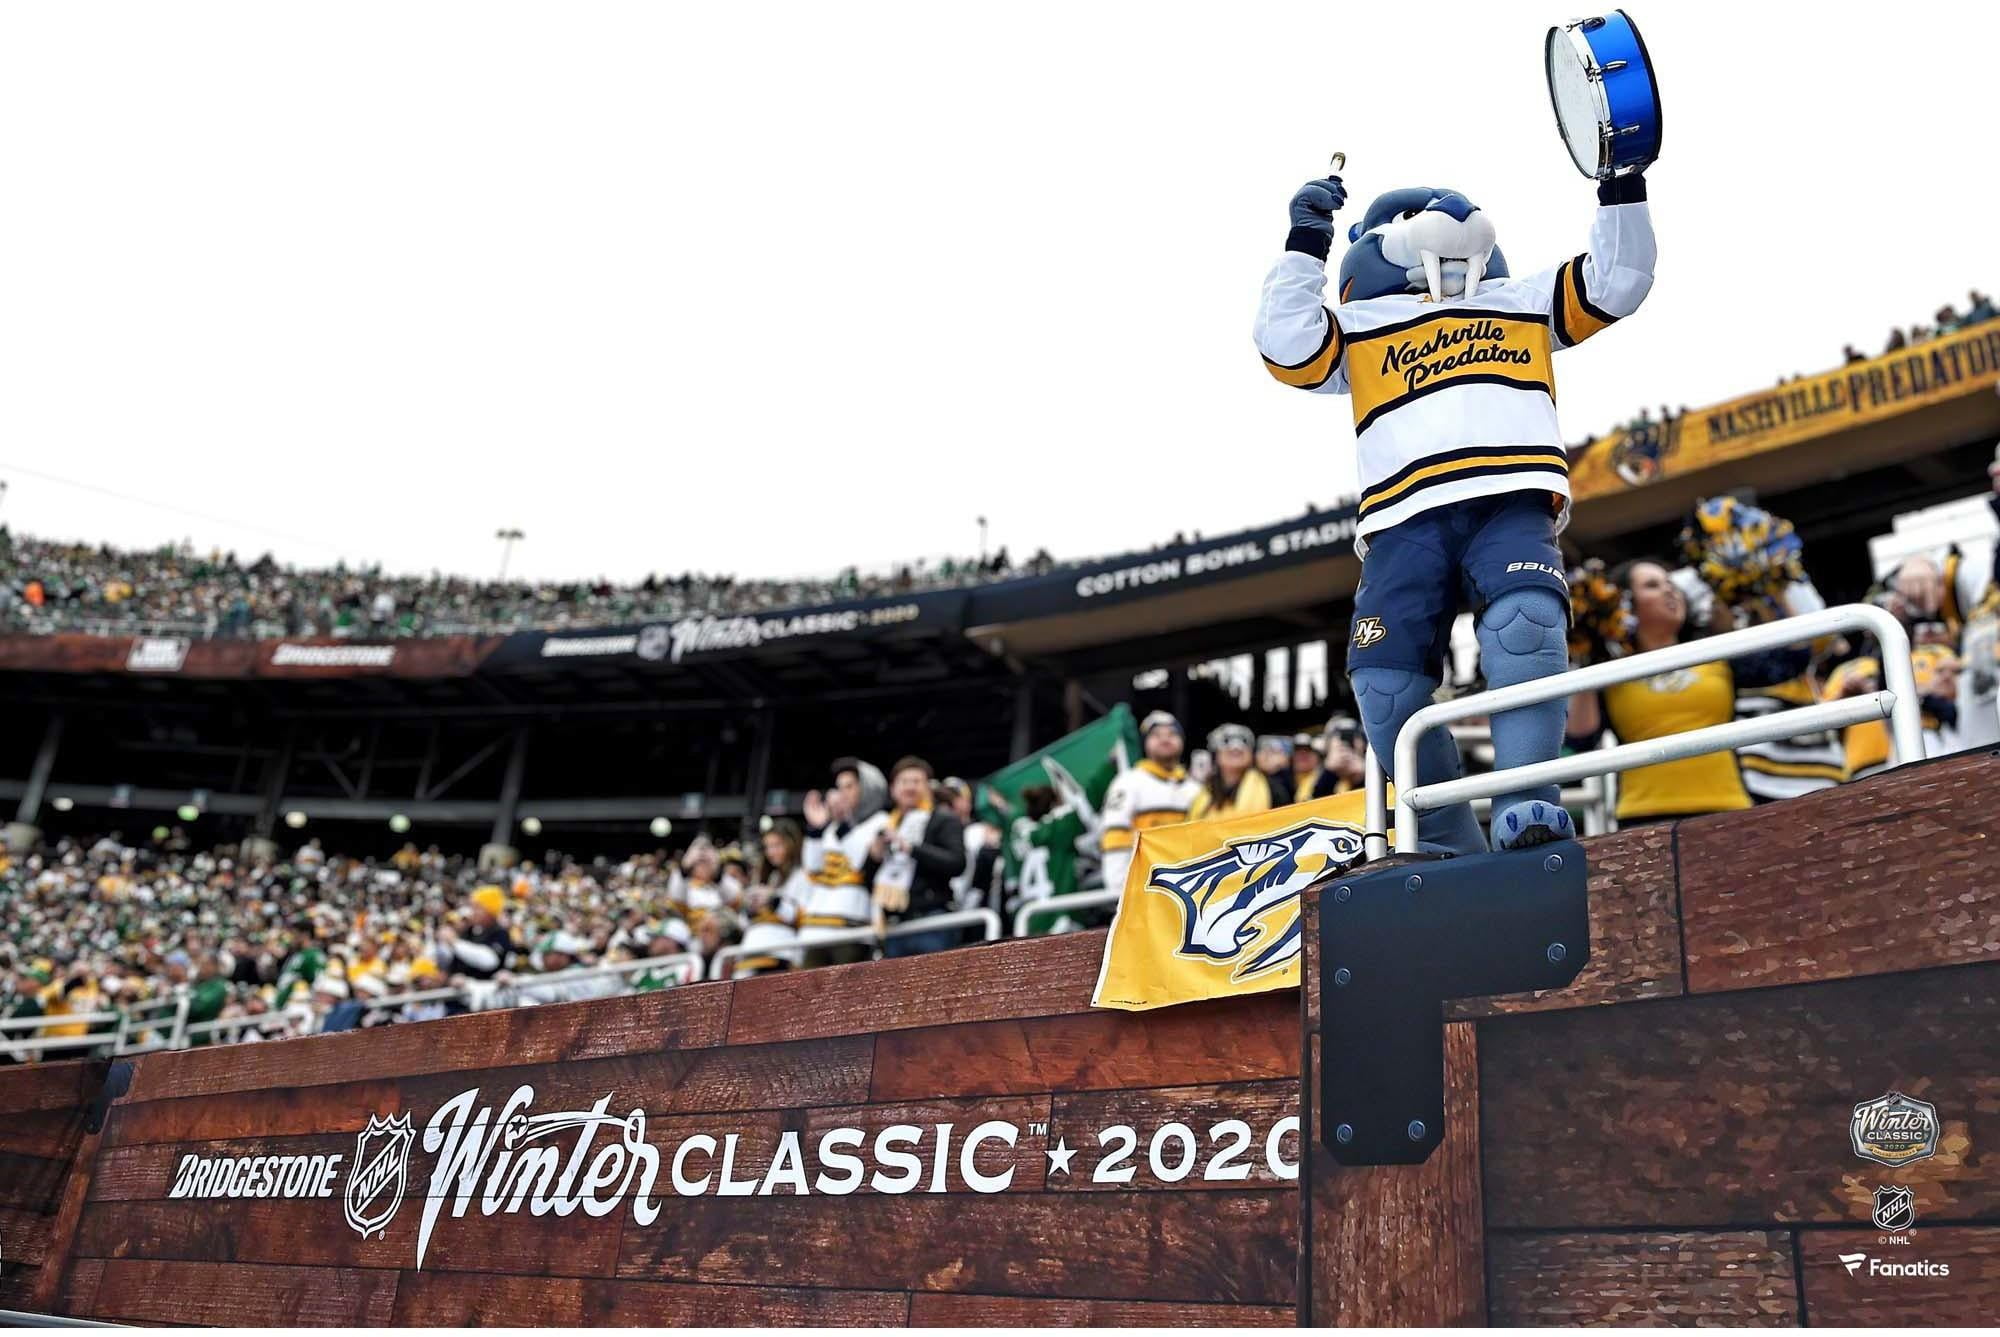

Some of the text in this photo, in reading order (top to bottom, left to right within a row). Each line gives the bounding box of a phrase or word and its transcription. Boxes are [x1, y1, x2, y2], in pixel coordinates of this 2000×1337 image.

[1381, 320, 1505, 376] Nashville
[1404, 343, 1531, 392] Predators
[1706, 379, 1848, 444] NASHVILLE
[1076, 559, 1180, 597] COTTON
[1185, 541, 1264, 575] BOWL
[168, 1154, 343, 1198] BRIDGESTONE
[356, 1145, 399, 1209] NHL
[415, 1084, 662, 1273] Winter
